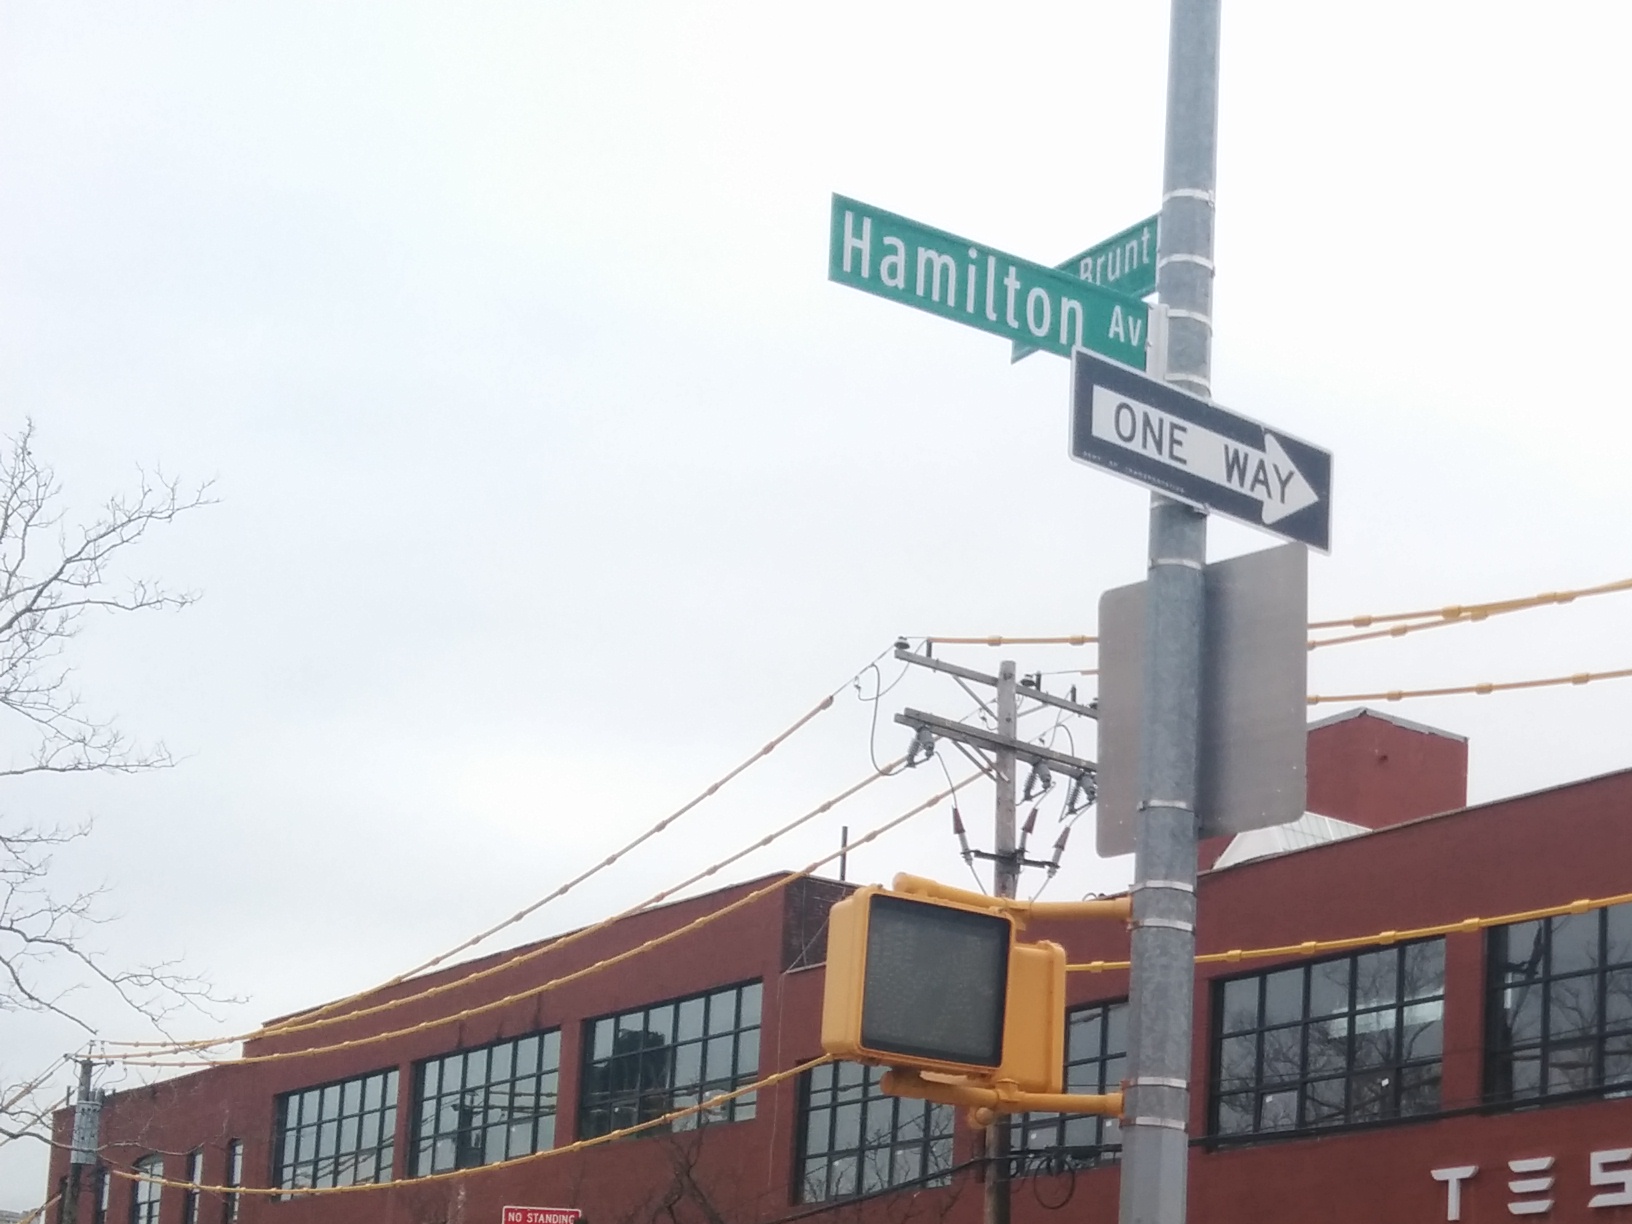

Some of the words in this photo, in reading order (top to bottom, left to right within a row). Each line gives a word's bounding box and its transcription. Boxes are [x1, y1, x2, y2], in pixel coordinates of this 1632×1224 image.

[843, 210, 1084, 349] Hamilton
[1108, 305, 1142, 347] Av
[1079, 226, 1150, 286] Brunt
[1114, 402, 1188, 466] ONE
[1224, 443, 1295, 504] WAY
[508, 1211, 522, 1223] NO
[526, 1212, 575, 1224] STANDING
